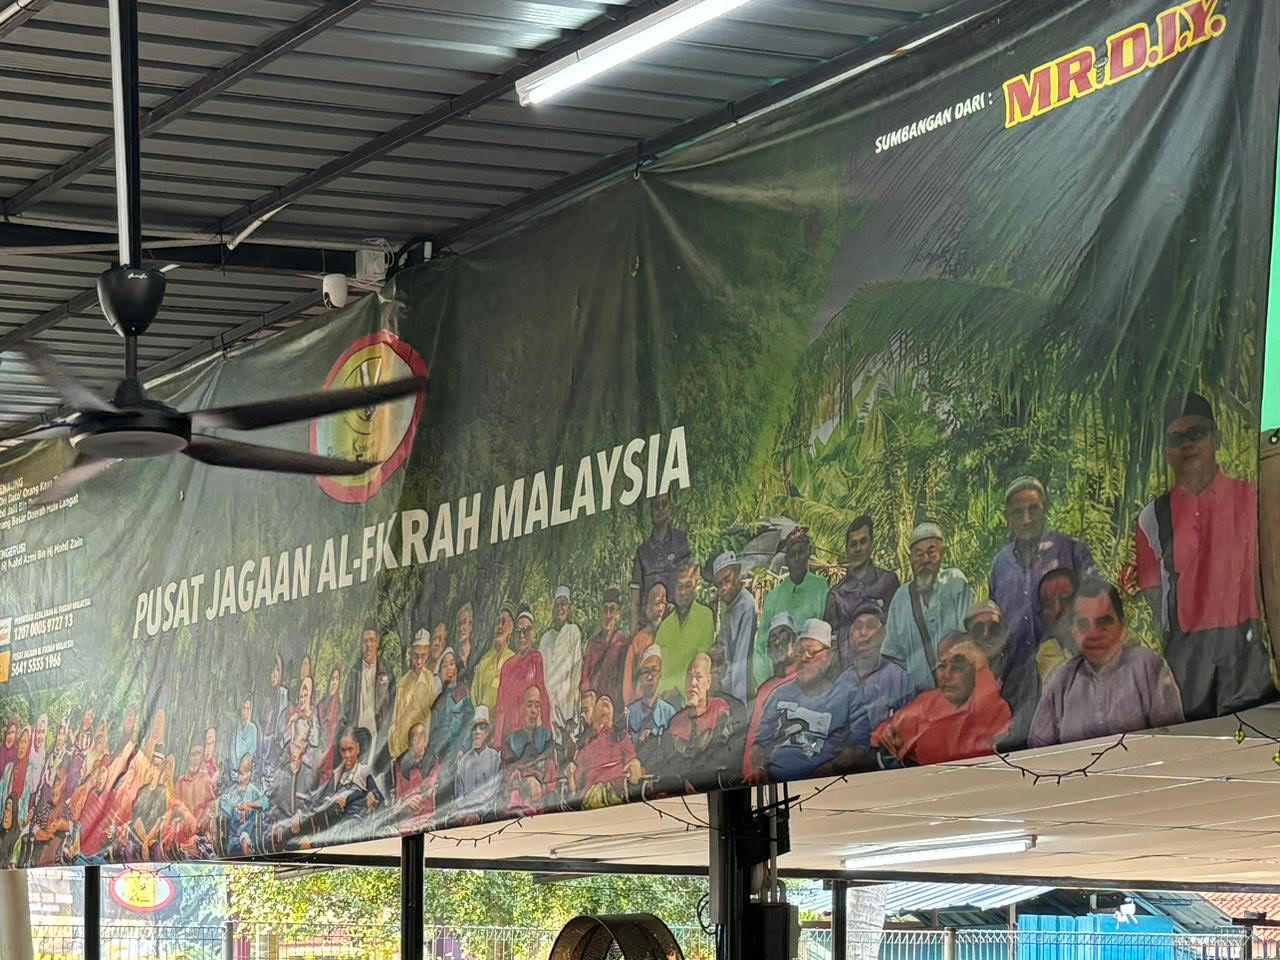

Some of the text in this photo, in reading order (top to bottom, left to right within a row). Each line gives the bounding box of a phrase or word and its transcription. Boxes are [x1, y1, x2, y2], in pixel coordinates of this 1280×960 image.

[875, 107, 952, 154] SUMBANGAN
[954, 92, 985, 120] DARI
[132, 574, 205, 640] PUSAT
[206, 544, 312, 621] JAGAAN
[490, 425, 690, 545] MALAYSIA
[65, 613, 74, 628] 13
